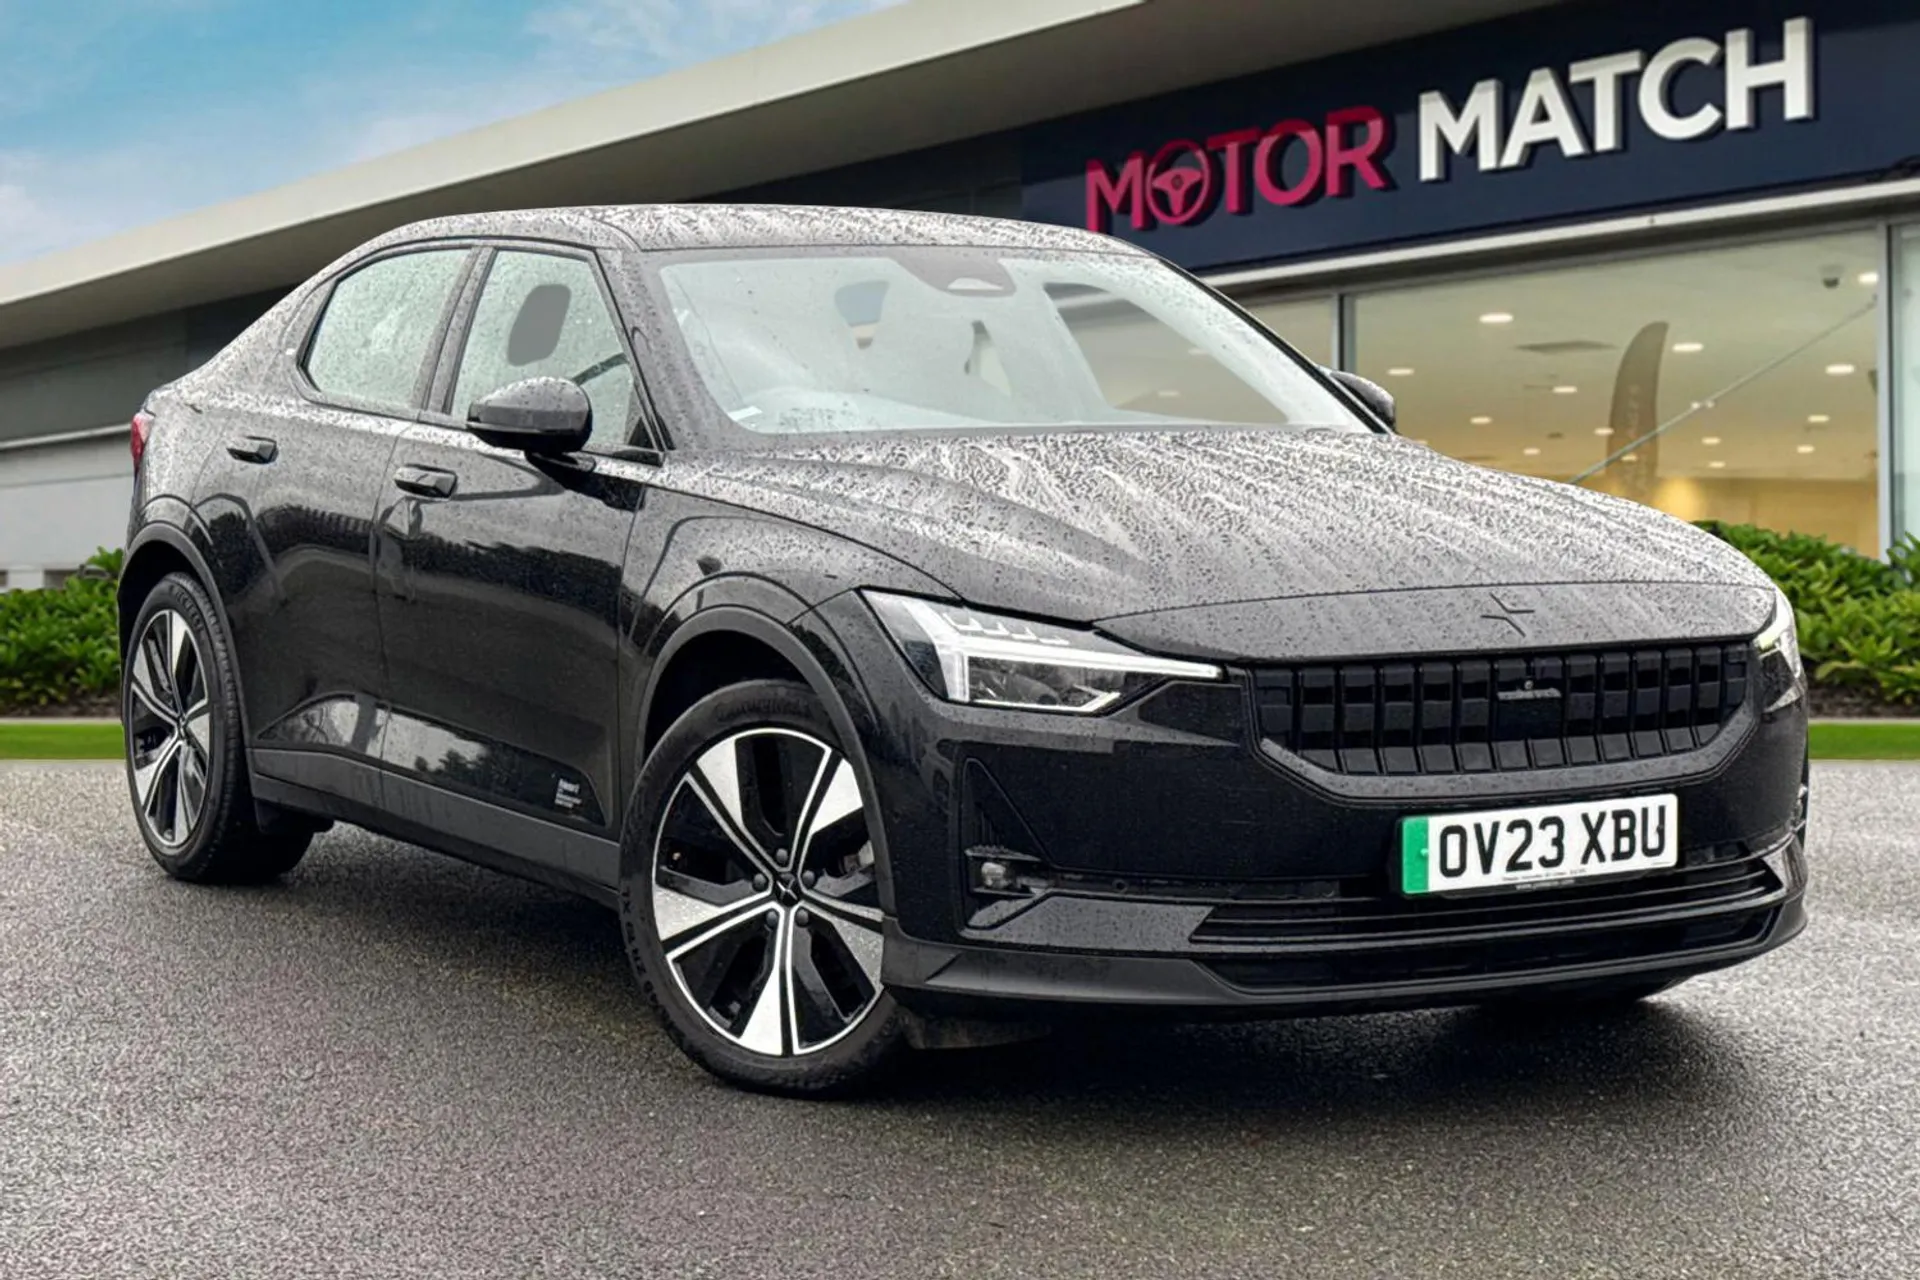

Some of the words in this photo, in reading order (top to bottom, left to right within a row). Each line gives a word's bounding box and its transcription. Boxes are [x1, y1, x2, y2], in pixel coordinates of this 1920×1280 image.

[1085, 105, 1387, 232] MOTOR
[1419, 16, 1813, 182] MATCH
[1439, 816, 1565, 878] OV23
[1581, 805, 1666, 865] XBU
